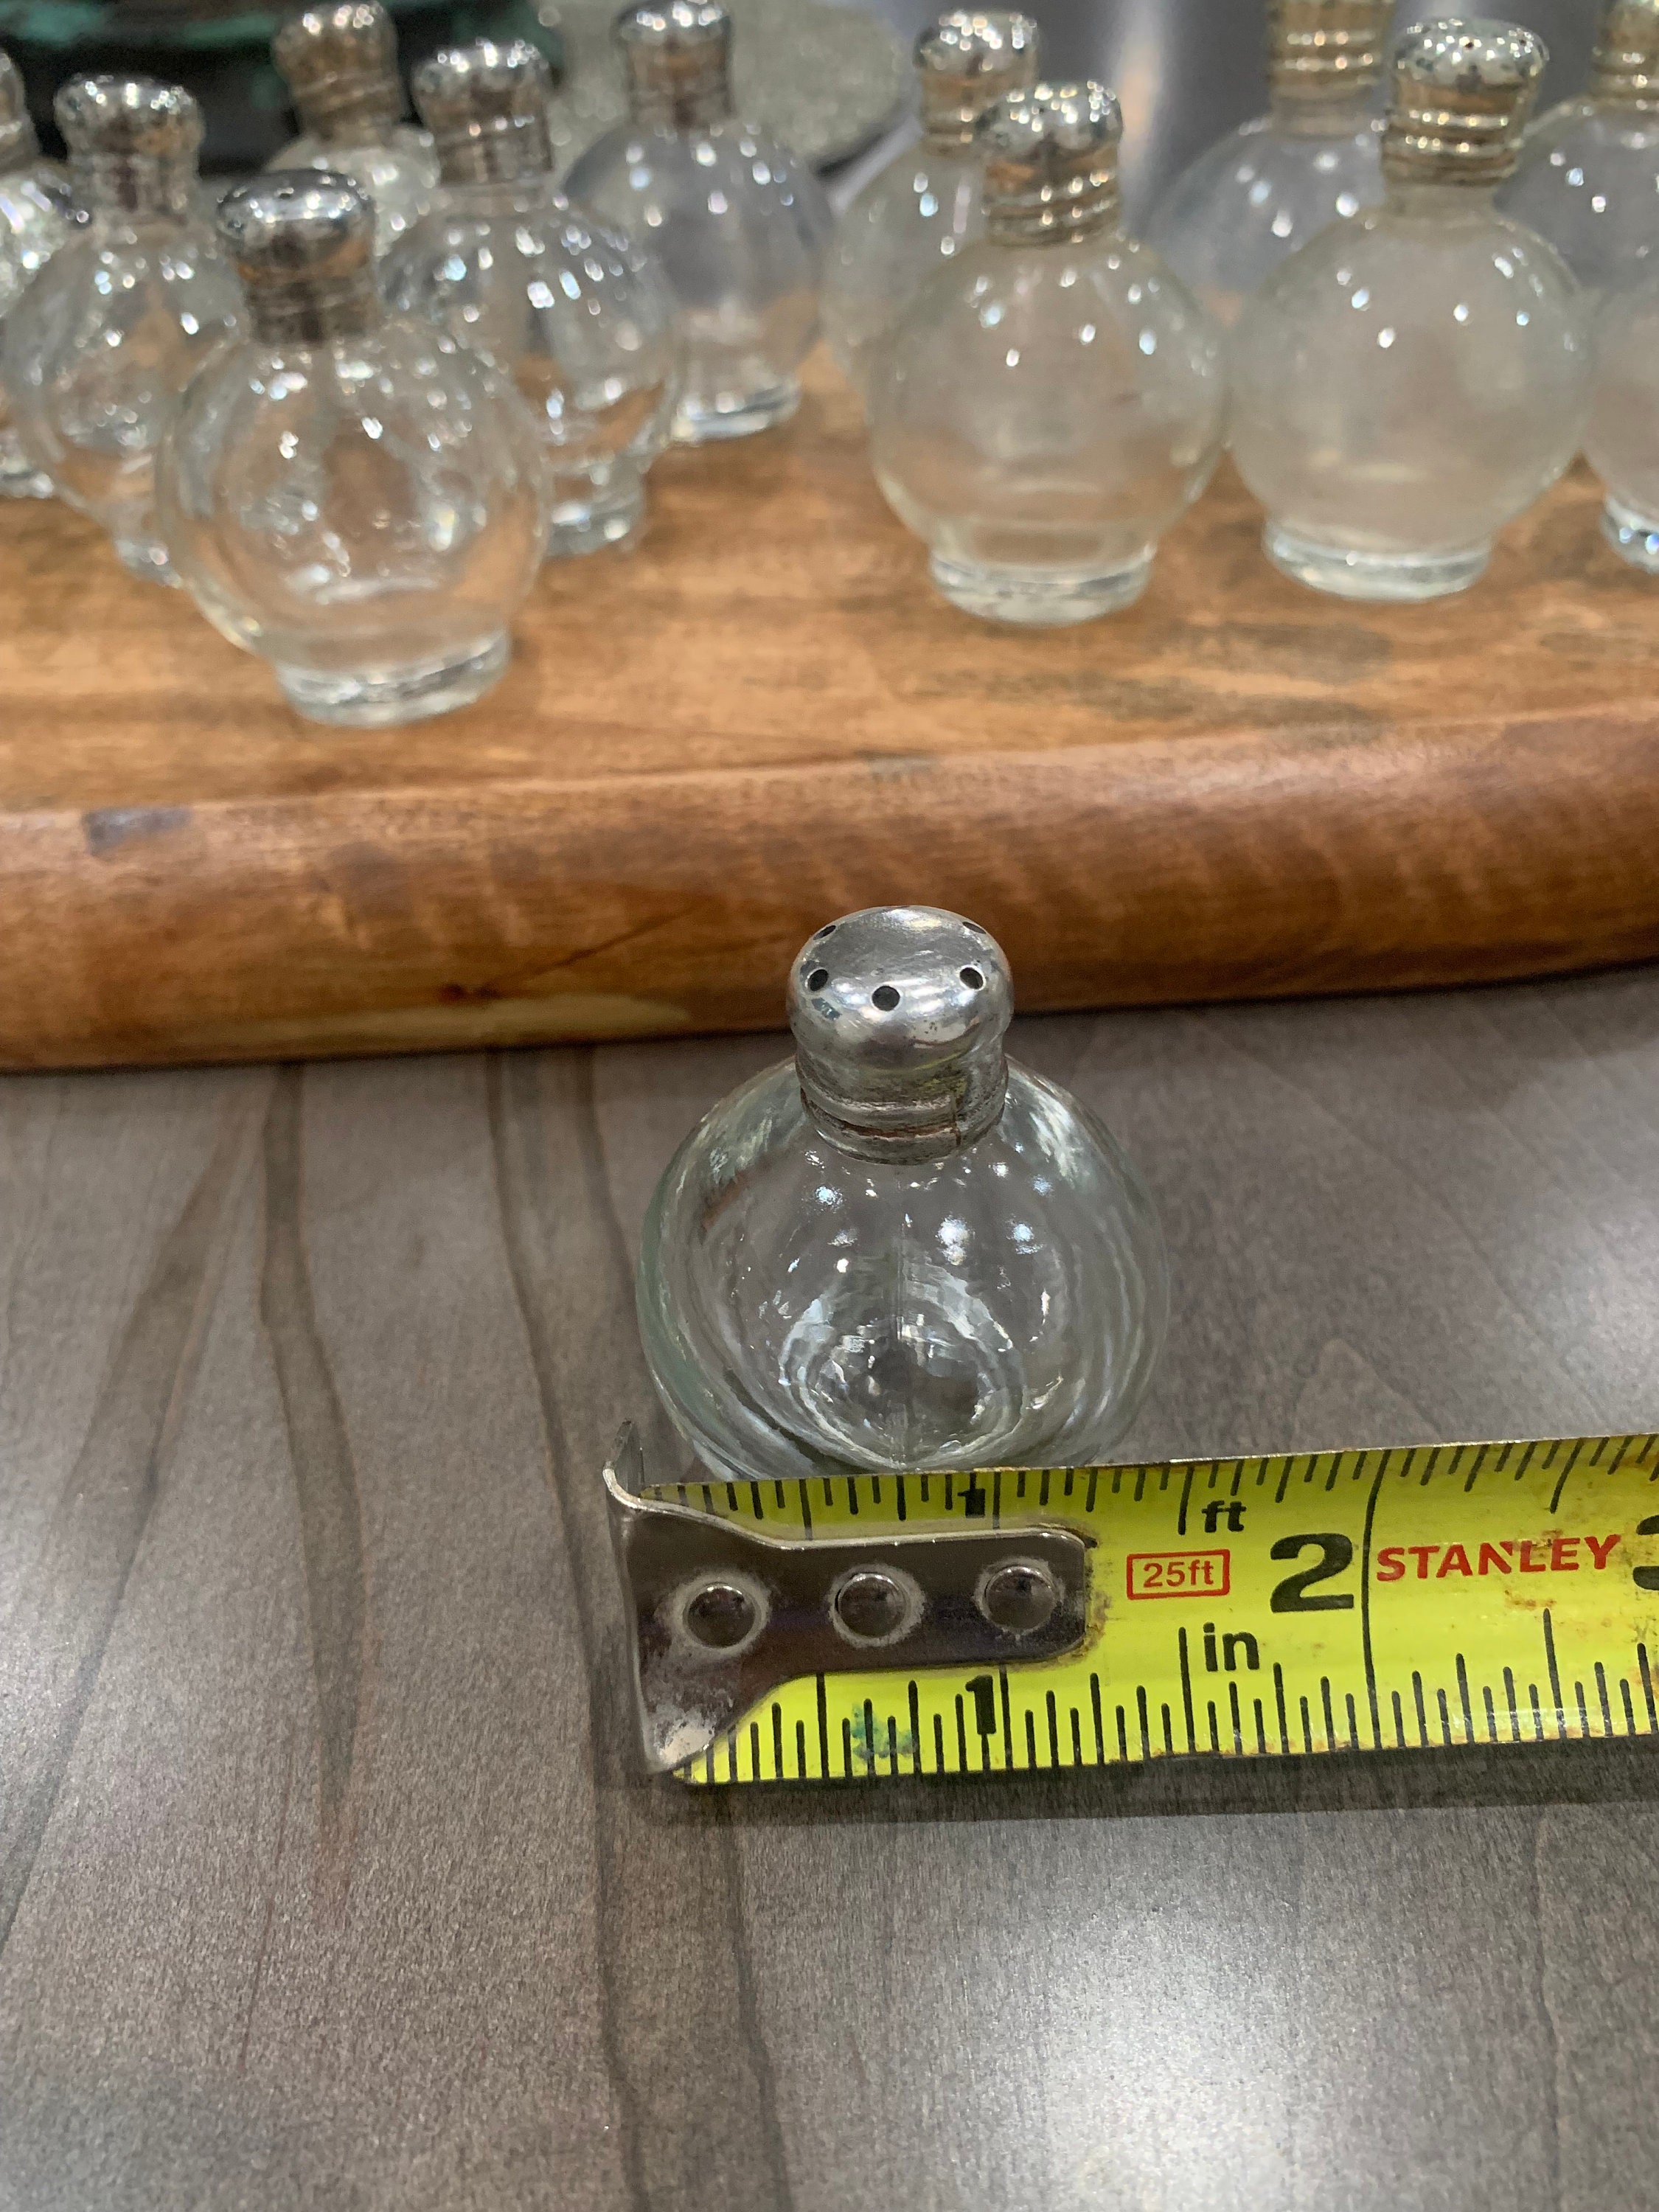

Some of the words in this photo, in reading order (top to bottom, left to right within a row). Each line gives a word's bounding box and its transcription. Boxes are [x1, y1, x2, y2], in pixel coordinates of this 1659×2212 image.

[958, 1486, 986, 1517] 1
[1202, 1500, 1246, 1532] ft
[1143, 1559, 1214, 1587] 25ft
[1270, 1533, 1354, 1613] 2
[1376, 1534, 1621, 1582] STANLEY
[1203, 1622, 1259, 1672] in
[965, 1674, 996, 1735] 1
